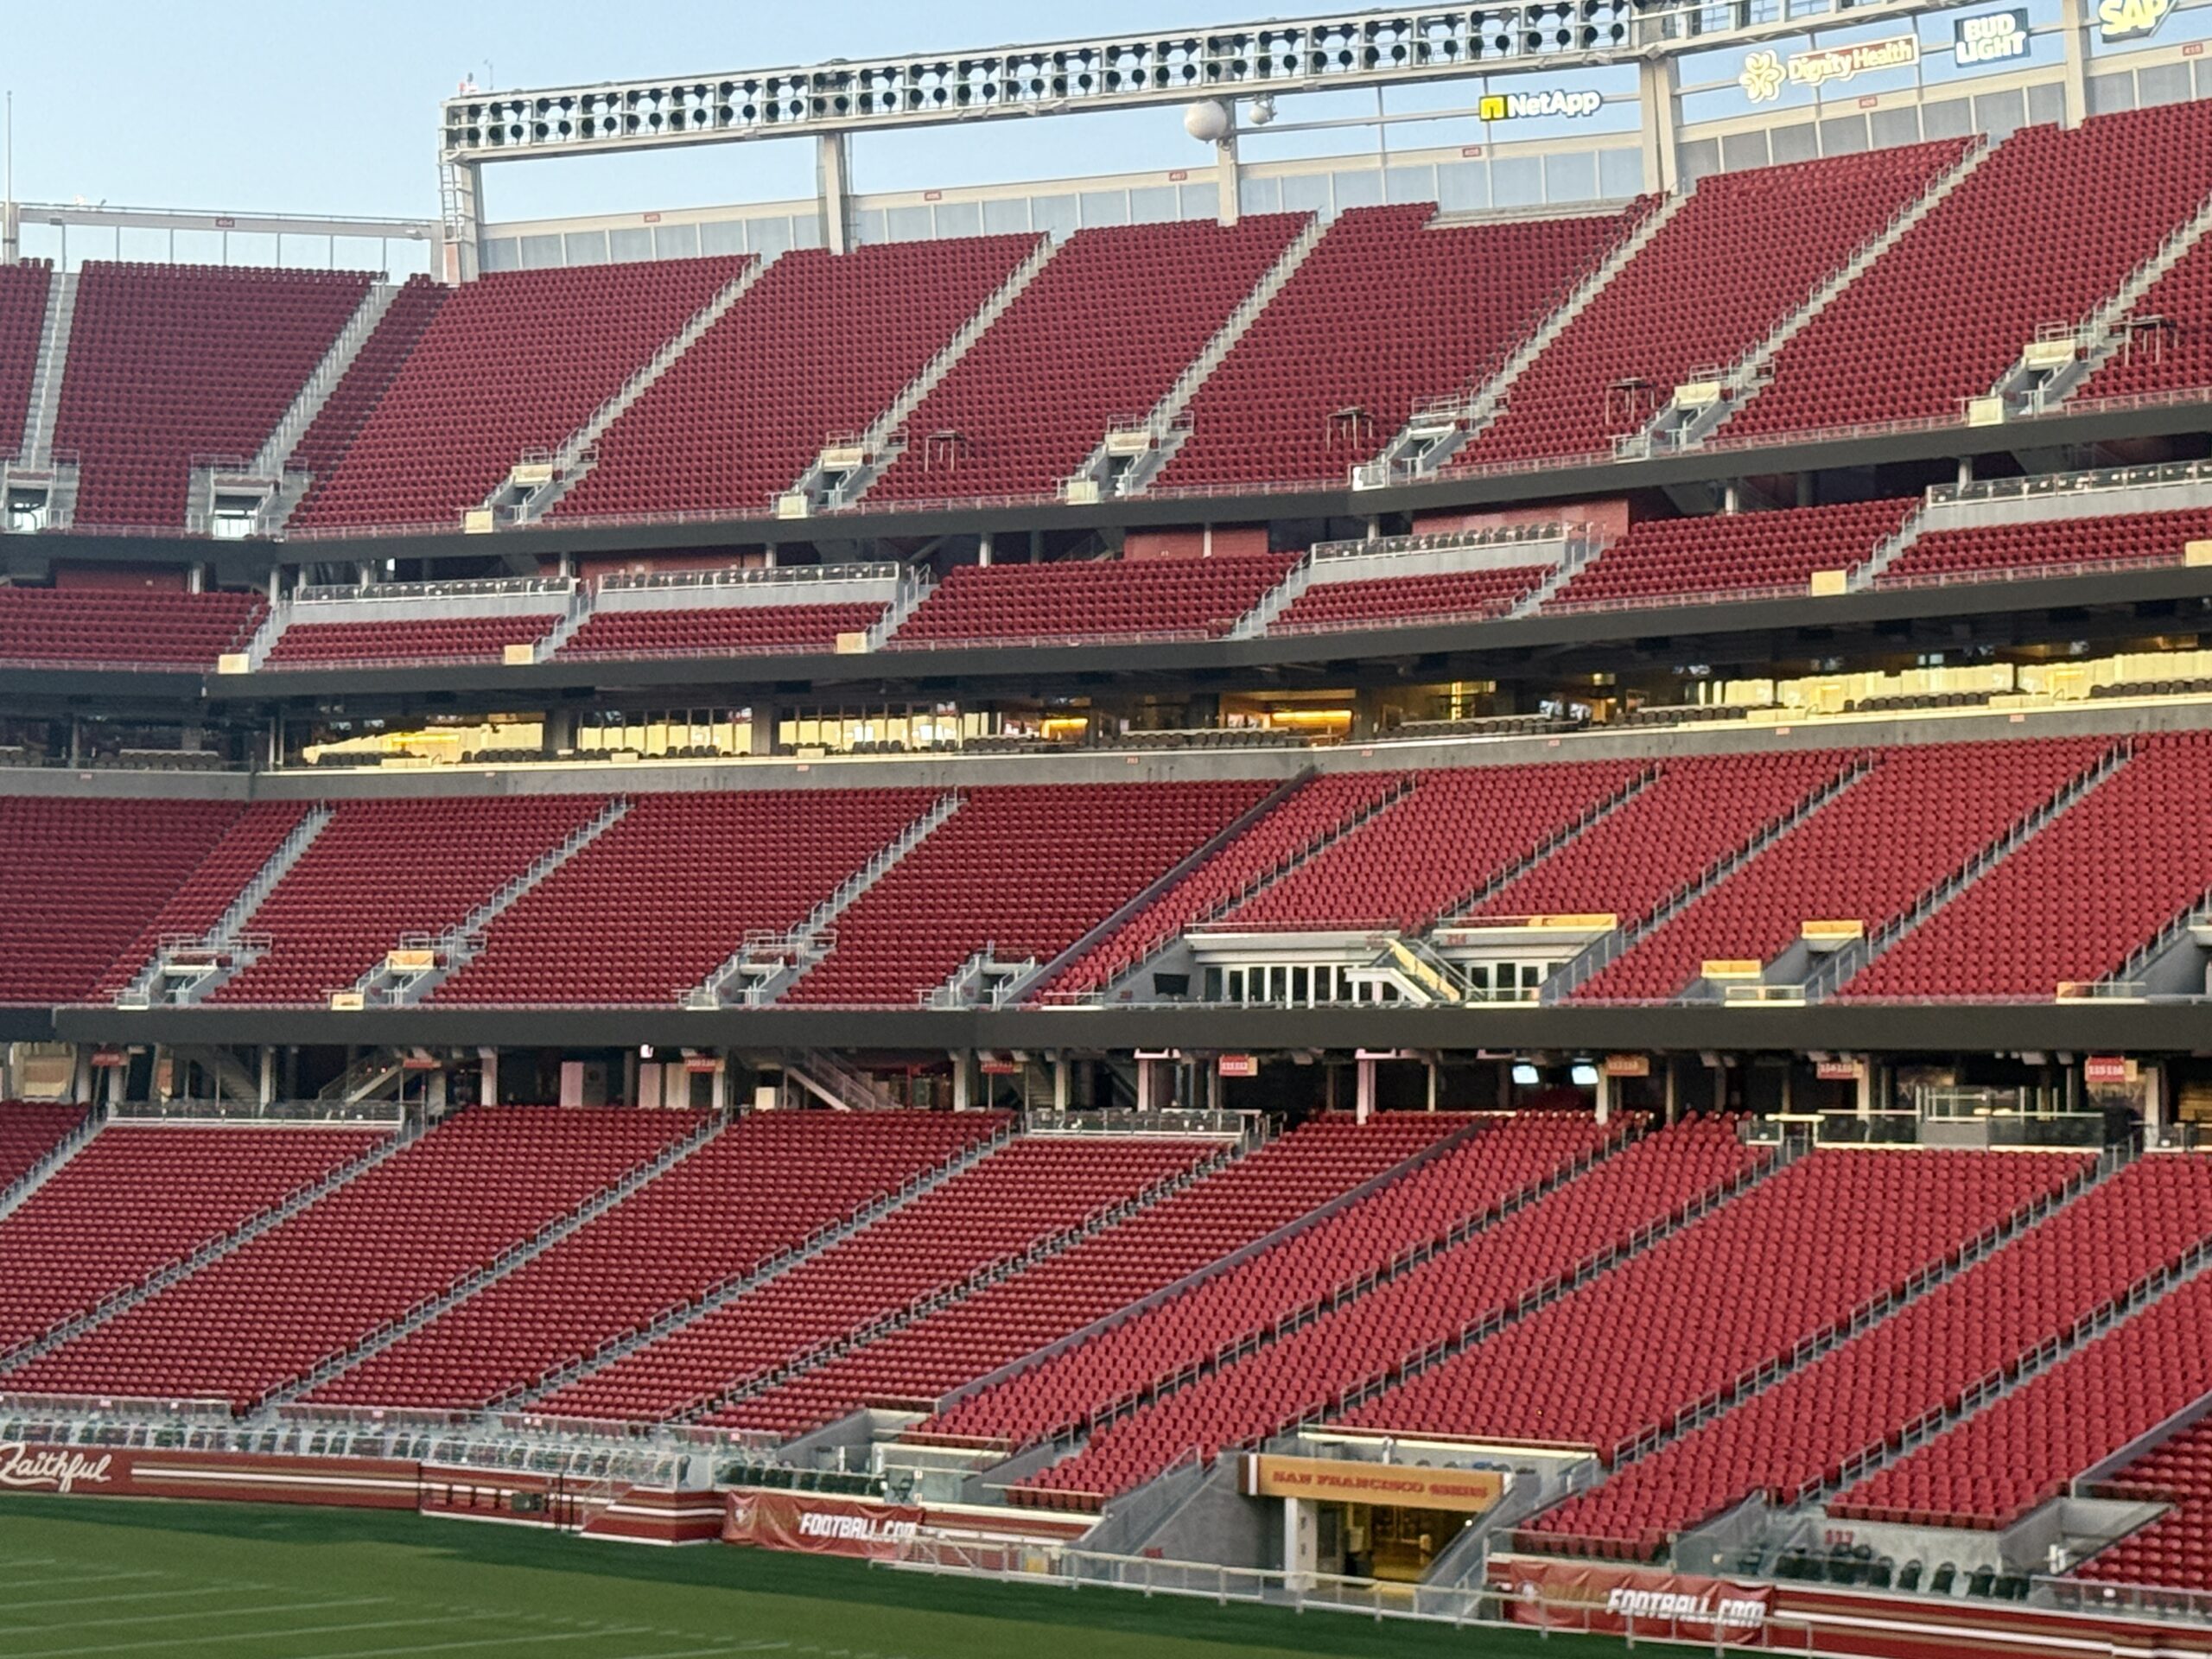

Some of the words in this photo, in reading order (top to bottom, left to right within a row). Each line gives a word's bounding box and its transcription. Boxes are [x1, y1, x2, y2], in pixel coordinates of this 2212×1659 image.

[1963, 13, 2016, 42] BUD
[1788, 51, 1853, 83] Dignity
[1853, 40, 1913, 69] Health
[1956, 31, 2026, 64] LIGHT
[1507, 90, 1601, 118] NetApp
[0, 1441, 112, 1493] Faithful
[1273, 1471, 1313, 1485] SAN
[1316, 1474, 1424, 1493] FRANCISCO
[799, 1512, 918, 1542] FOOTBALL.COM
[1605, 1587, 1766, 1629] FOOTBALL.COM
